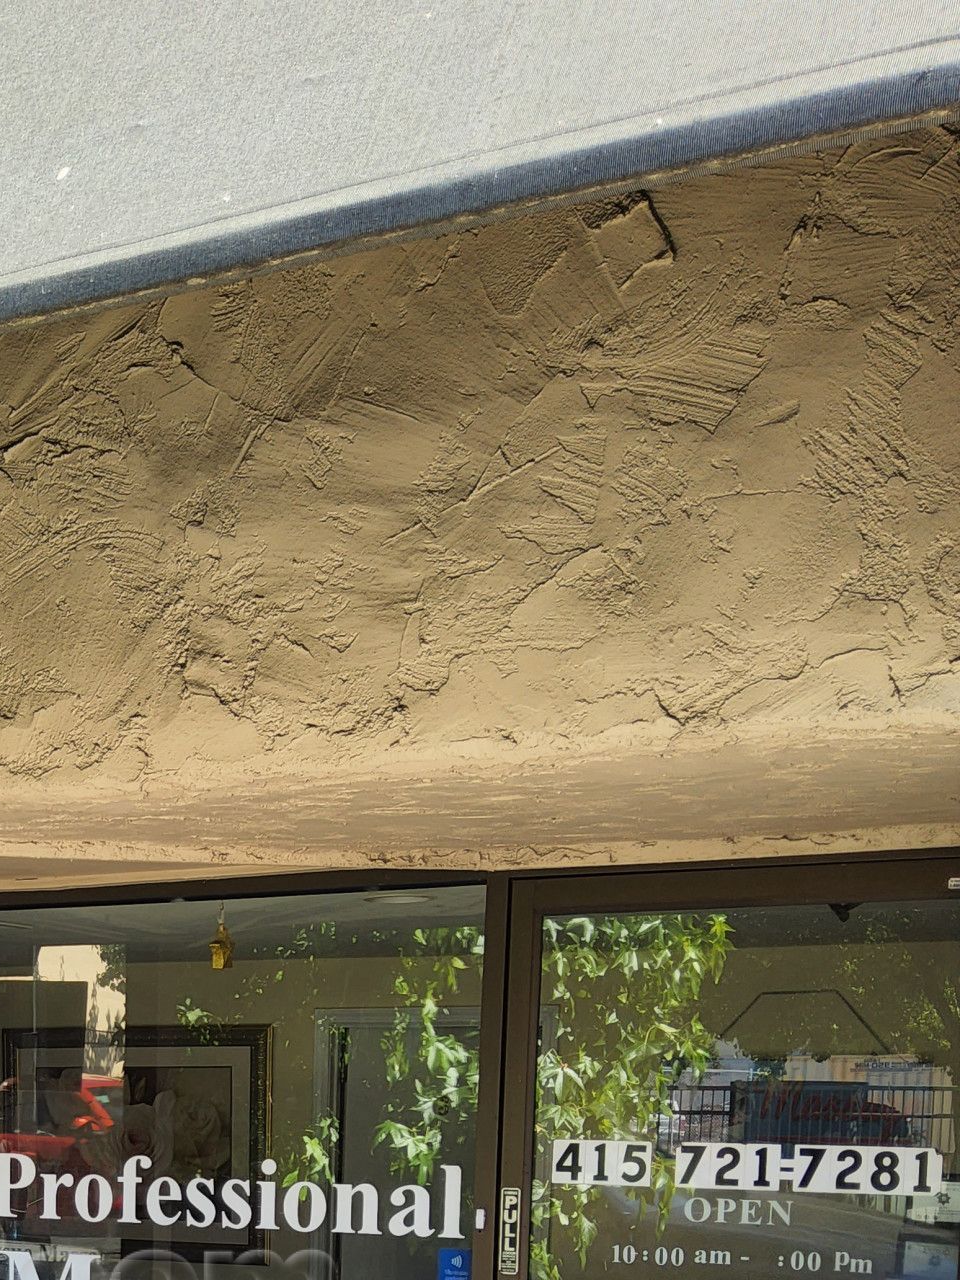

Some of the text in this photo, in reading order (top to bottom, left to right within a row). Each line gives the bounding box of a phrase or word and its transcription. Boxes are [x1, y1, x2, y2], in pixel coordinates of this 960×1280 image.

[555, 1142, 648, 1183] 415
[504, 1196, 517, 1252] PULL
[683, 1197, 792, 1227] OPEN
[611, 1244, 685, 1267] 10:00
[693, 1249, 731, 1266] am
